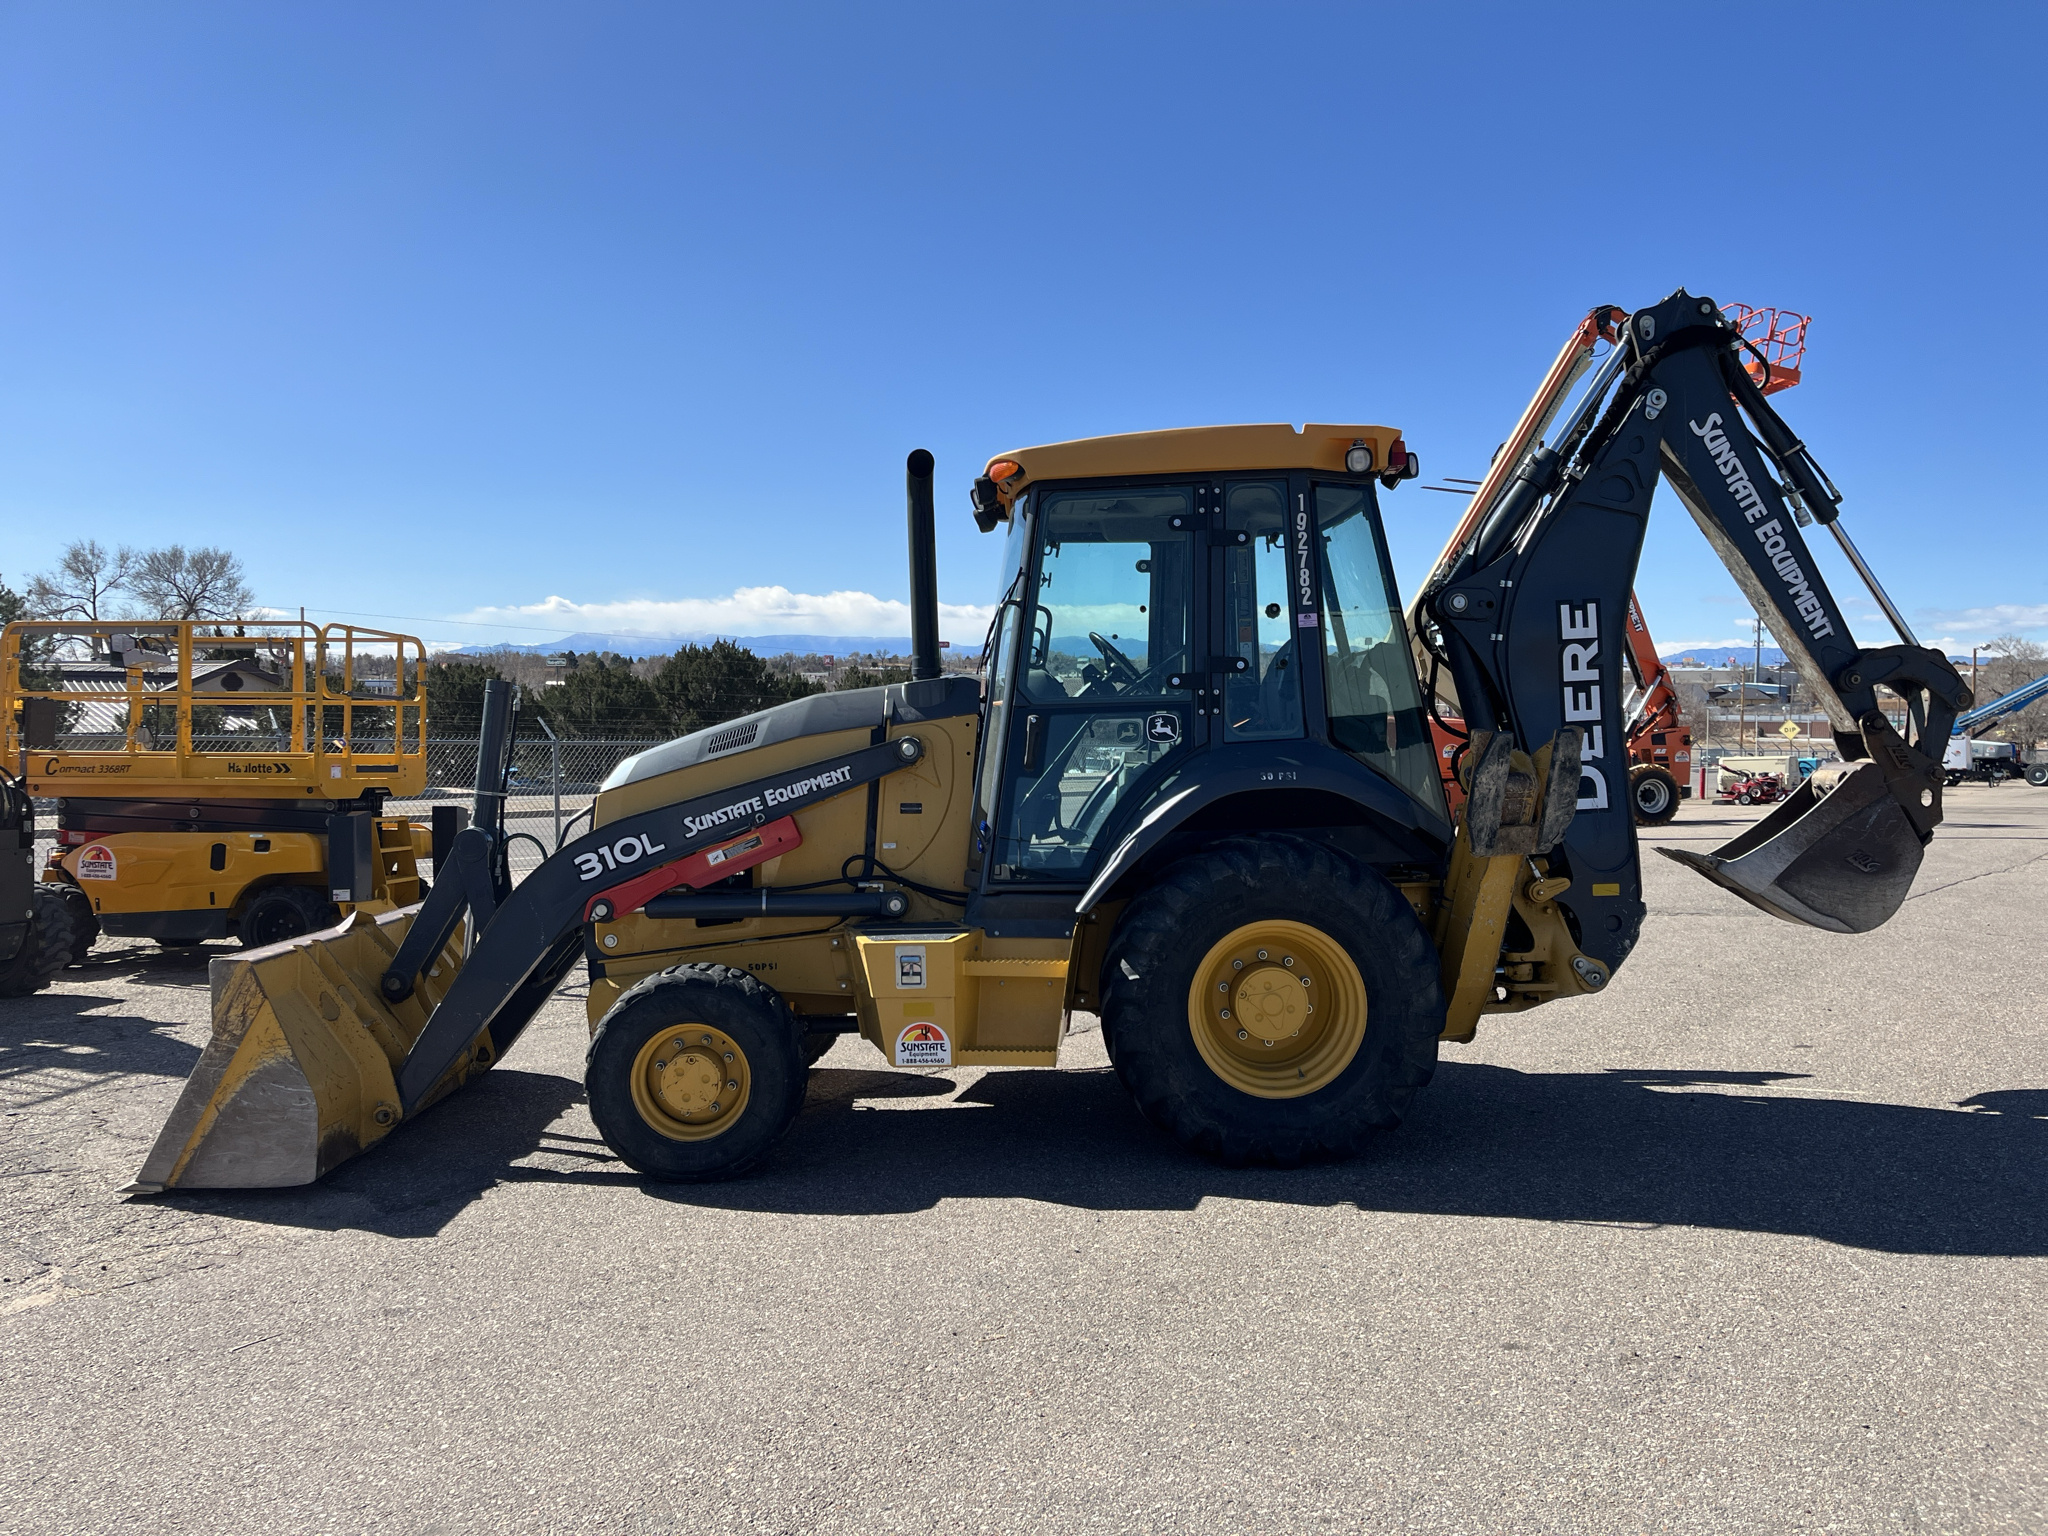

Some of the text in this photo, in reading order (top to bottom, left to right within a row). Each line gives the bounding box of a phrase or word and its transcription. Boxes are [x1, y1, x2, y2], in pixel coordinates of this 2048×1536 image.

[1296, 493, 1312, 605] 192782
[1689, 412, 1835, 640] SUNSTATE EQUIPMENT
[1560, 602, 1609, 811] DEERE
[98, 764, 132, 774] 3368RT
[1260, 772, 1274, 781] 30
[684, 765, 853, 839] SUNSTATE EQUIPMENT
[80, 860, 114, 870] SUNSTATE
[573, 833, 665, 881] 310L
[900, 1042, 947, 1053] SUNSTATE
